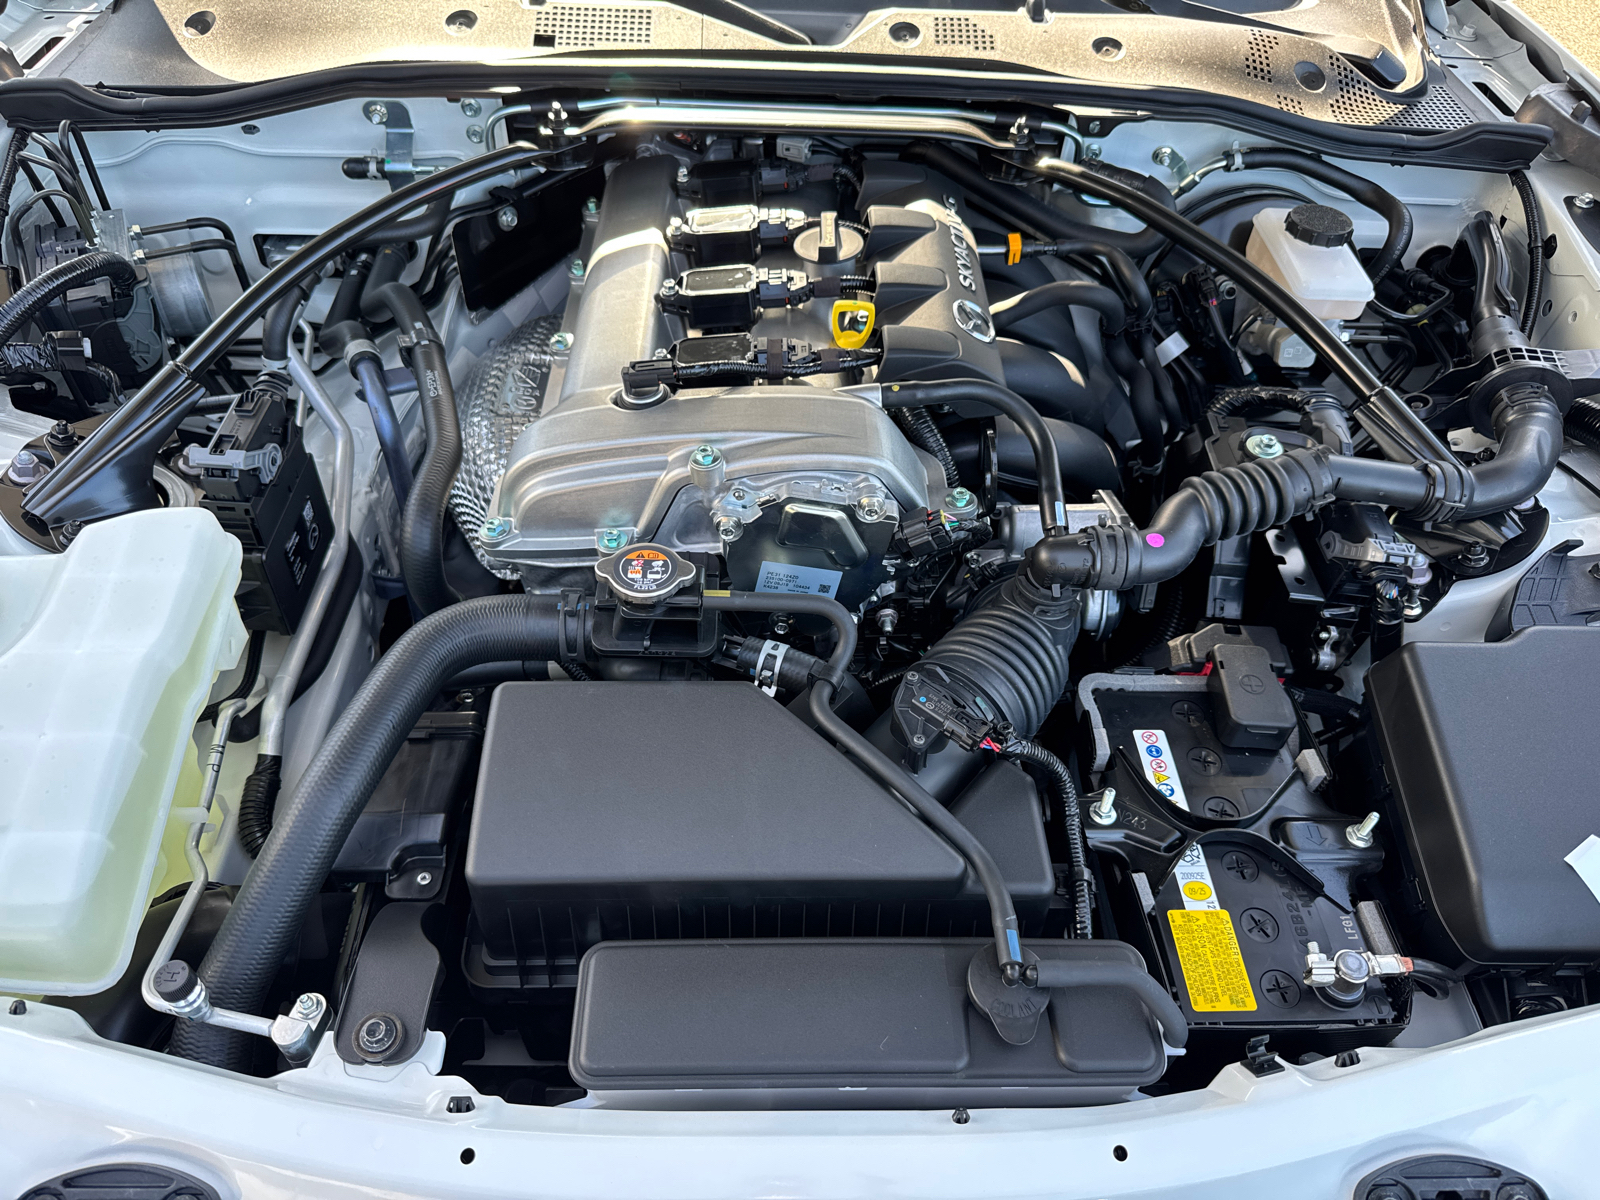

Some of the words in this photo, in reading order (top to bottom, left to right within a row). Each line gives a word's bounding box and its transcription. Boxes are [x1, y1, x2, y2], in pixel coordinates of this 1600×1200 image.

[942, 193, 976, 292] SKYACTIV-G
[1188, 887, 1206, 895] 09/25
[1206, 901, 1217, 910] 12
[1193, 924, 1207, 948] POISON
[1200, 949, 1211, 967] CAUSES
[1207, 946, 1217, 958] CAPS
[1223, 926, 1239, 955] DANGER
[1232, 957, 1245, 981] EXPLOSIVE
[1240, 982, 1250, 998] GASES
[1190, 974, 1202, 996] CHILDREN
[1205, 968, 1216, 986] SEVERE
[1215, 972, 1223, 982] AND
[1210, 986, 1221, 1002] BURNS
[1218, 983, 1228, 997] LEVEL
